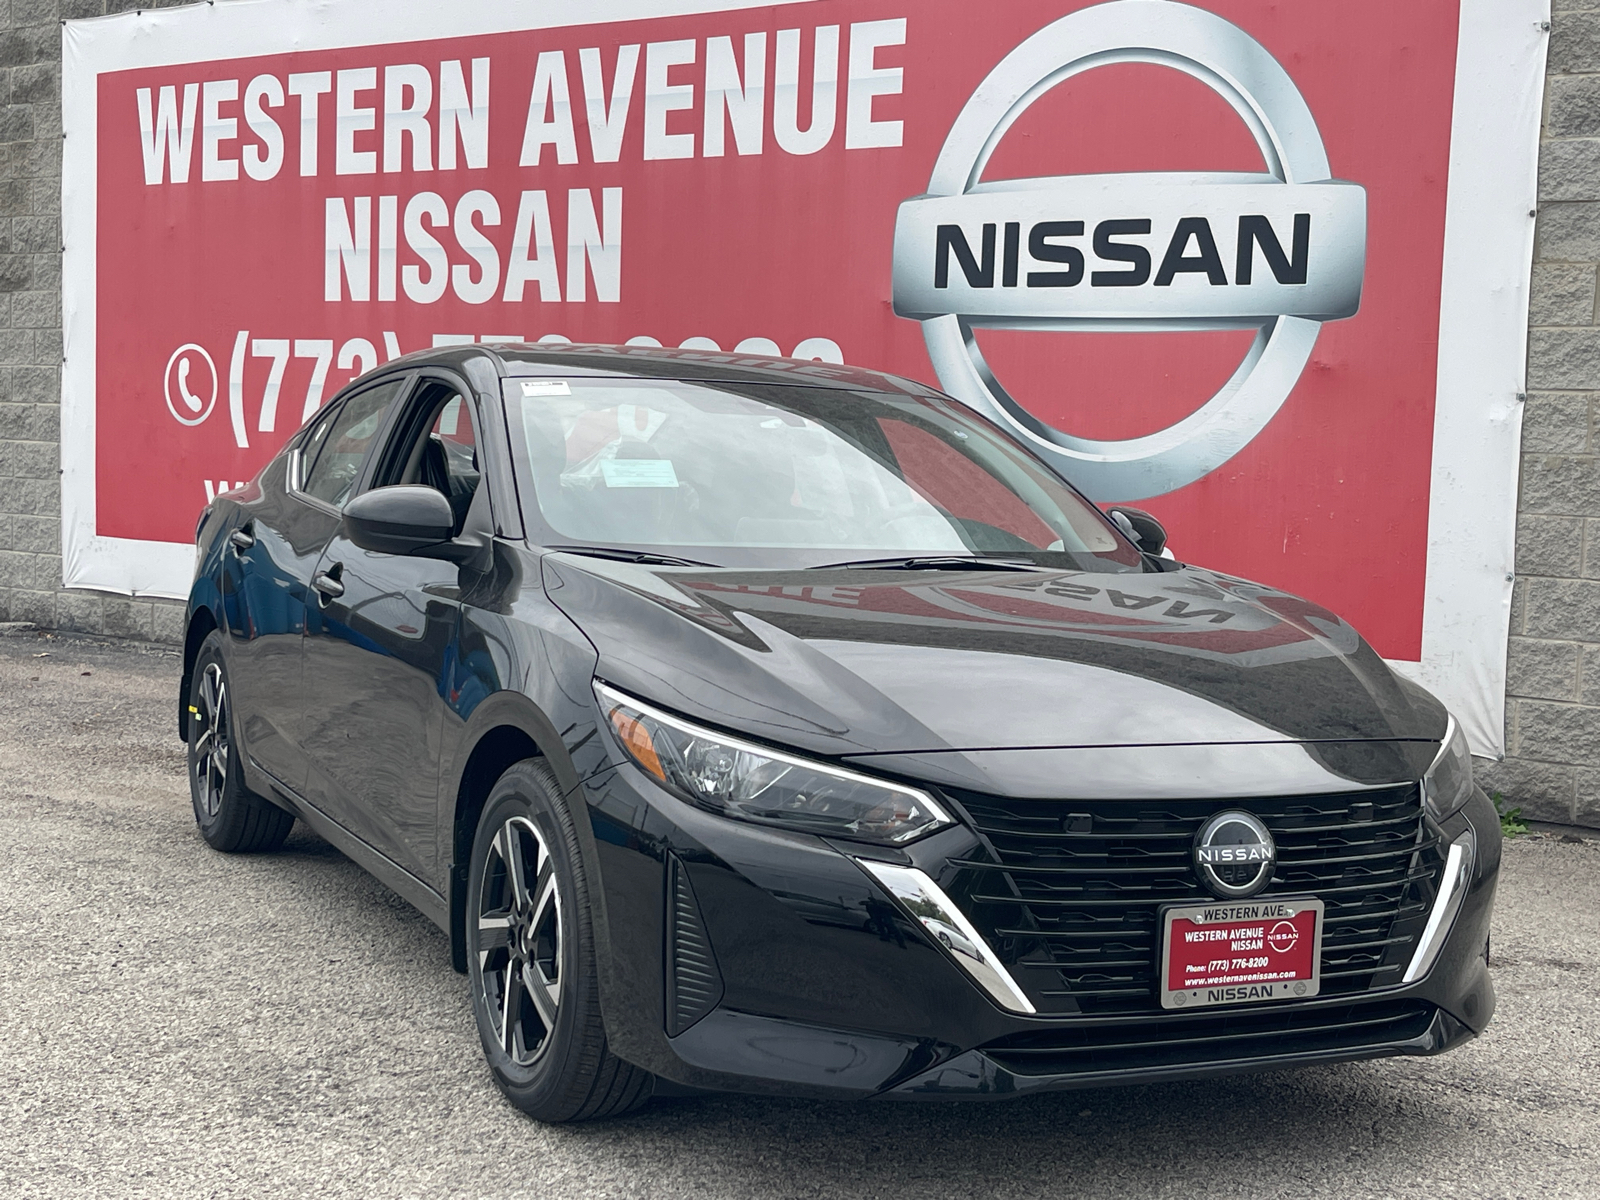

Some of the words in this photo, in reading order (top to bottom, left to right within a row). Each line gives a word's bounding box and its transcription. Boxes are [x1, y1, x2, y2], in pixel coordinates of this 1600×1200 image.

[136, 57, 491, 186] WESTERN
[519, 17, 907, 167] AVENUE
[324, 187, 624, 304] NISSAN
[934, 213, 1311, 289] NISSAN
[1198, 847, 1272, 862] NISSAN
[1203, 906, 1258, 921] WESTERN
[1185, 930, 1228, 943] WESTERN
[1229, 927, 1264, 940] AVENUE
[1267, 932, 1299, 941] NISSAN
[1231, 939, 1263, 952] NISSAN
[1208, 959, 1229, 973] (773)
[1231, 956, 1269, 970] 776-8200
[1184, 971, 1296, 986] www.westernavenissan.com
[1207, 985, 1273, 1002] NISSAN
